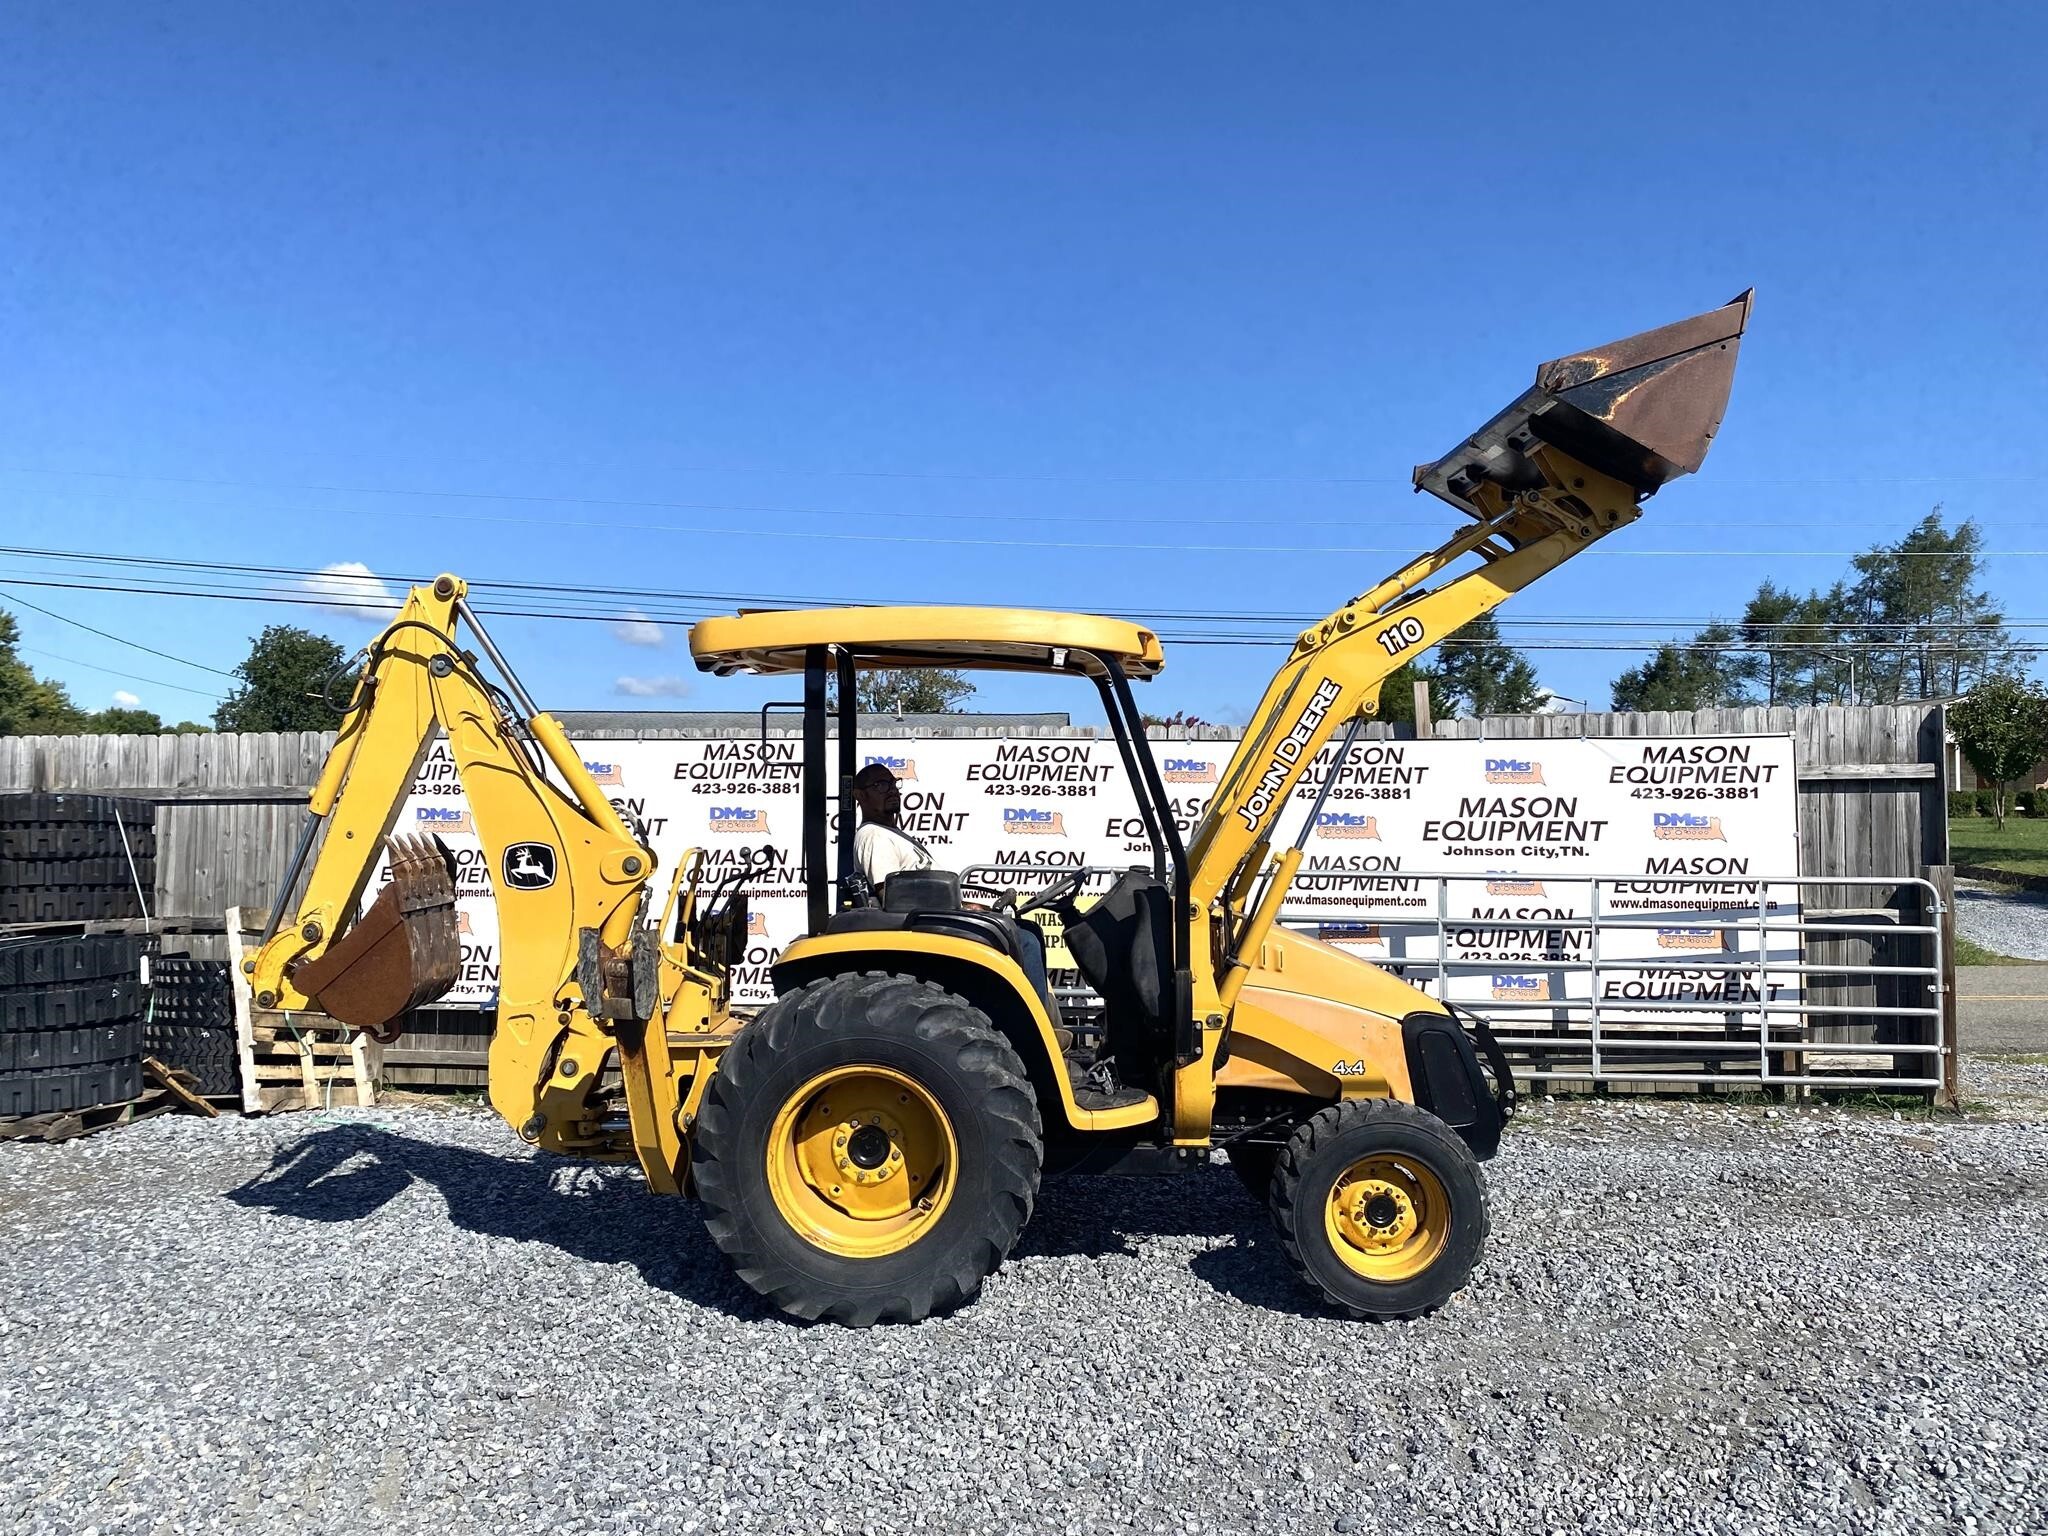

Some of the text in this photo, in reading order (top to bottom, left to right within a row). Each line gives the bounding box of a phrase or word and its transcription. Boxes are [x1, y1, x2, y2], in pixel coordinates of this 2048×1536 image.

[1376, 617, 1424, 656] 110
[703, 743, 795, 761] MASON
[996, 745, 1091, 763] MASON
[1238, 677, 1343, 831] JOHN DEERE
[1642, 745, 1750, 764] MASON
[673, 762, 802, 780] EQUIPMEN
[966, 763, 1114, 782] EQUIPMENT
[1609, 765, 1779, 784] EQUIPMENT
[691, 782, 800, 794] 423-926-3881
[984, 784, 1097, 797] 423-926-3881
[1296, 788, 1411, 800] 42-926-3881
[1630, 786, 1759, 800] 423-926-3881
[1458, 797, 1577, 818] MASON
[1422, 820, 1608, 842] EQUIPMENT
[995, 850, 1085, 866] MASON
[1443, 845, 1515, 857] Johnson
[1309, 855, 1401, 872] MASON
[1645, 857, 1749, 875] MASON
[1610, 898, 1778, 912] www.dmasonequipment.cm
[1332, 1060, 1365, 1075] 4x4
